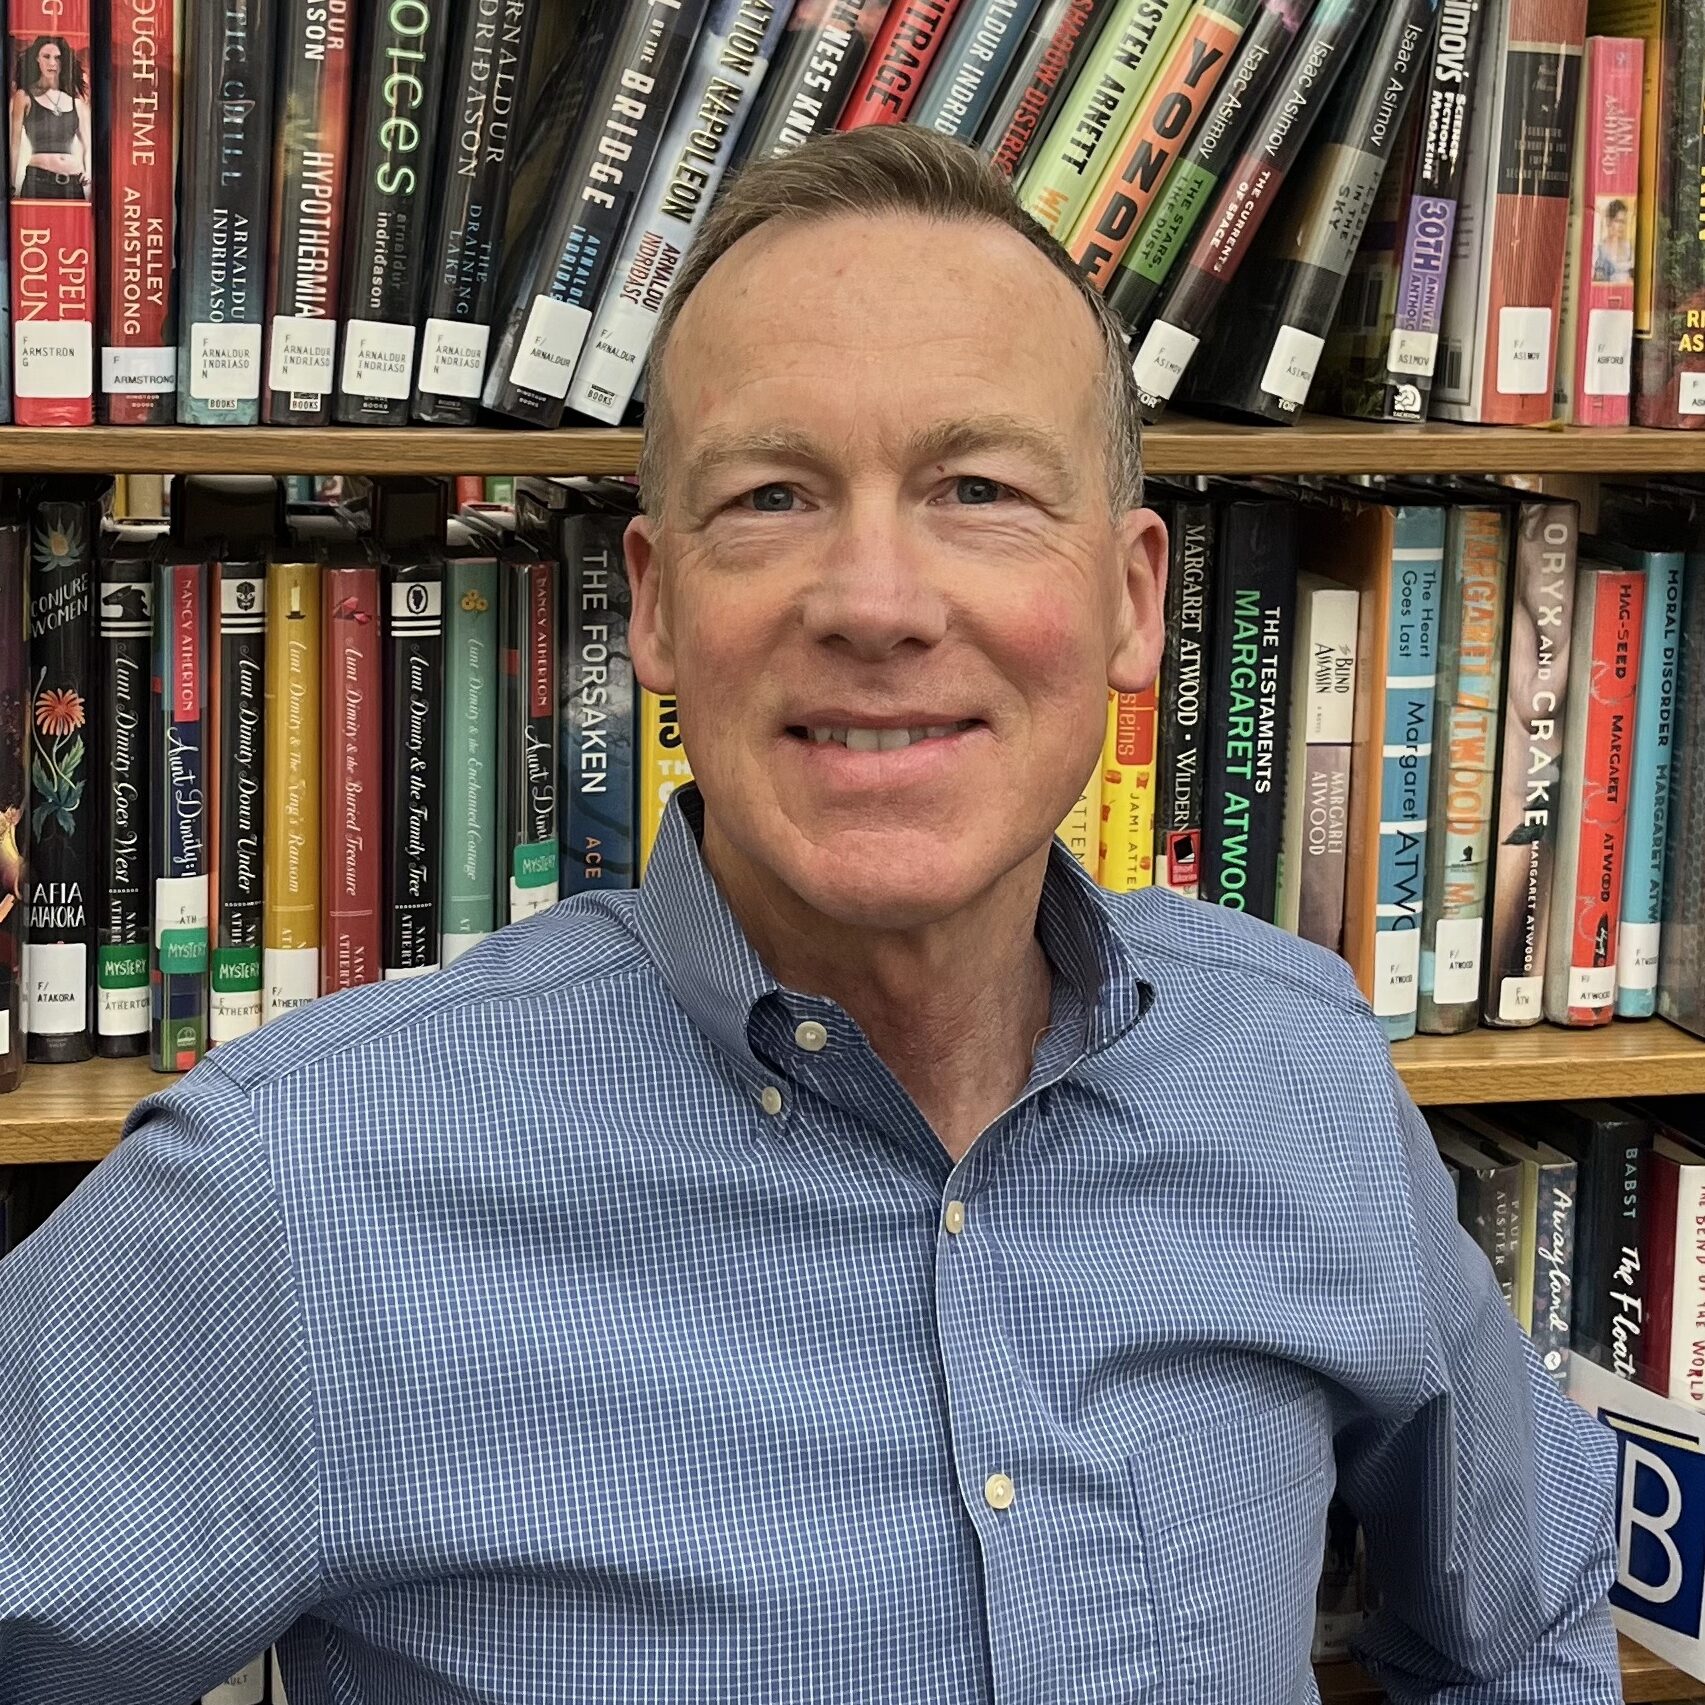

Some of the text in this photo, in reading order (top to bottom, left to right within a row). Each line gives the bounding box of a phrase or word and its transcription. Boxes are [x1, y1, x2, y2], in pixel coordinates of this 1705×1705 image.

[640, 39, 661, 63] THE
[653, 20, 665, 39] BY
[1034, 0, 1095, 88] SHADOW
[1199, 43, 1270, 160] Isaac Asimov
[1263, 40, 1334, 158] Isaac Asimov
[1369, 22, 1424, 149] Isaac Asimov
[131, 91, 160, 167] TIME
[220, 79, 246, 187] CHILL
[580, 67, 656, 210] BRIDGE
[660, 76, 745, 224] NAPOLEON
[1061, 73, 1125, 175] ARNETT
[1421, 89, 1443, 180] MAGAZINE
[1448, 92, 1467, 157] SCIENCE
[1183, 178, 1204, 211] THE
[1209, 181, 1249, 249] OF SPACE
[1212, 170, 1272, 274] THE CURRENTS
[1326, 185, 1351, 234] SKY
[1338, 184, 1364, 242] IN THE
[123, 186, 142, 336] ARMSTRONG
[146, 217, 163, 306] KELLEY
[295, 151, 335, 318] HYPOTHERMIA
[443, 229, 462, 286] LAKE
[456, 204, 483, 315] DRAINING
[1140, 222, 1168, 261] DUST
[1411, 201, 1450, 273] 30TH
[230, 213, 250, 320] ARNALDU
[22, 348, 76, 358] ARMSTRON
[113, 375, 175, 386] ARMSTRONG
[202, 349, 250, 359] ARNALDUR
[530, 348, 572, 368] ARNALDUR
[594, 340, 636, 363] ARNALDUR
[1397, 354, 1430, 366] ASIMOV
[209, 399, 236, 409] BOOKS
[291, 400, 319, 411] BOOKS
[586, 389, 613, 406] BOOKS
[31, 572, 89, 619] CONJURE
[31, 595, 88, 638] WOMEN
[1176, 523, 1206, 726] MARGARET ATWOOD
[1398, 570, 1418, 659] Goes Last
[1418, 570, 1438, 659] The Heart
[181, 579, 194, 711] NANCY ATHERTON
[345, 639, 364, 681] Aunt
[536, 577, 549, 707] NANCY ATHERTON
[1615, 584, 1633, 680] HAG-SEED
[113, 643, 139, 701] Aunt
[239, 645, 261, 699] Aunt
[464, 676, 483, 722] Dimity
[580, 549, 609, 794] THE FORSAKEN
[1225, 588, 1261, 781] MARGARET
[1313, 642, 1335, 694] ASSASSIN
[1334, 657, 1354, 695] BLIND
[1524, 522, 1569, 828] ORYX AND CRAKE
[287, 682, 307, 733] Dimity
[342, 684, 364, 740] Dimity
[1255, 605, 1281, 795] THE TESTAMENTS
[1649, 569, 1679, 872] MORAL DISORDER MARGARET
[110, 703, 139, 778] Dimity
[167, 727, 199, 787] Aunt
[235, 701, 261, 769] Dimity
[524, 725, 552, 785] Aunt
[1398, 700, 1426, 820] Margaret
[1446, 691, 1491, 837] ATWOOD
[1606, 714, 1625, 805] MARGARET
[237, 770, 260, 830] Down
[404, 645, 430, 898] Aunt Dimity & the Family Tree
[465, 757, 484, 828] Enchanted
[112, 781, 139, 827] Goes
[344, 777, 364, 832] Buried
[1128, 792, 1140, 833] JAMI
[1308, 770, 1329, 857] ATWOOD
[1327, 771, 1346, 856] MARGARET
[113, 831, 139, 884] West
[236, 833, 260, 894] Under
[288, 831, 306, 893] Ransom
[343, 833, 364, 897] Treasure
[464, 829, 484, 881] Cottage
[584, 836, 602, 879] ACE
[1599, 832, 1616, 903] ATWOOD
[30, 905, 87, 929] ATAKORA
[32, 882, 84, 904] AFIA
[179, 915, 197, 925] ATH
[1523, 840, 1541, 972] MARGARET ATWOOD
[37, 981, 49, 991] F/
[37, 993, 76, 1003] ATAKORA
[104, 959, 147, 977] MYSTERY
[1580, 990, 1611, 1001] ATWOOD
[1494, 1190, 1507, 1267] AUSTER
[1509, 1200, 1520, 1251] PAUL
[1613, 1147, 1641, 1286] BABST The
[1537, 1187, 1574, 1333] Awayland
[1686, 1339, 1705, 1402] WORLD
[1616, 1438, 1684, 1604] B
